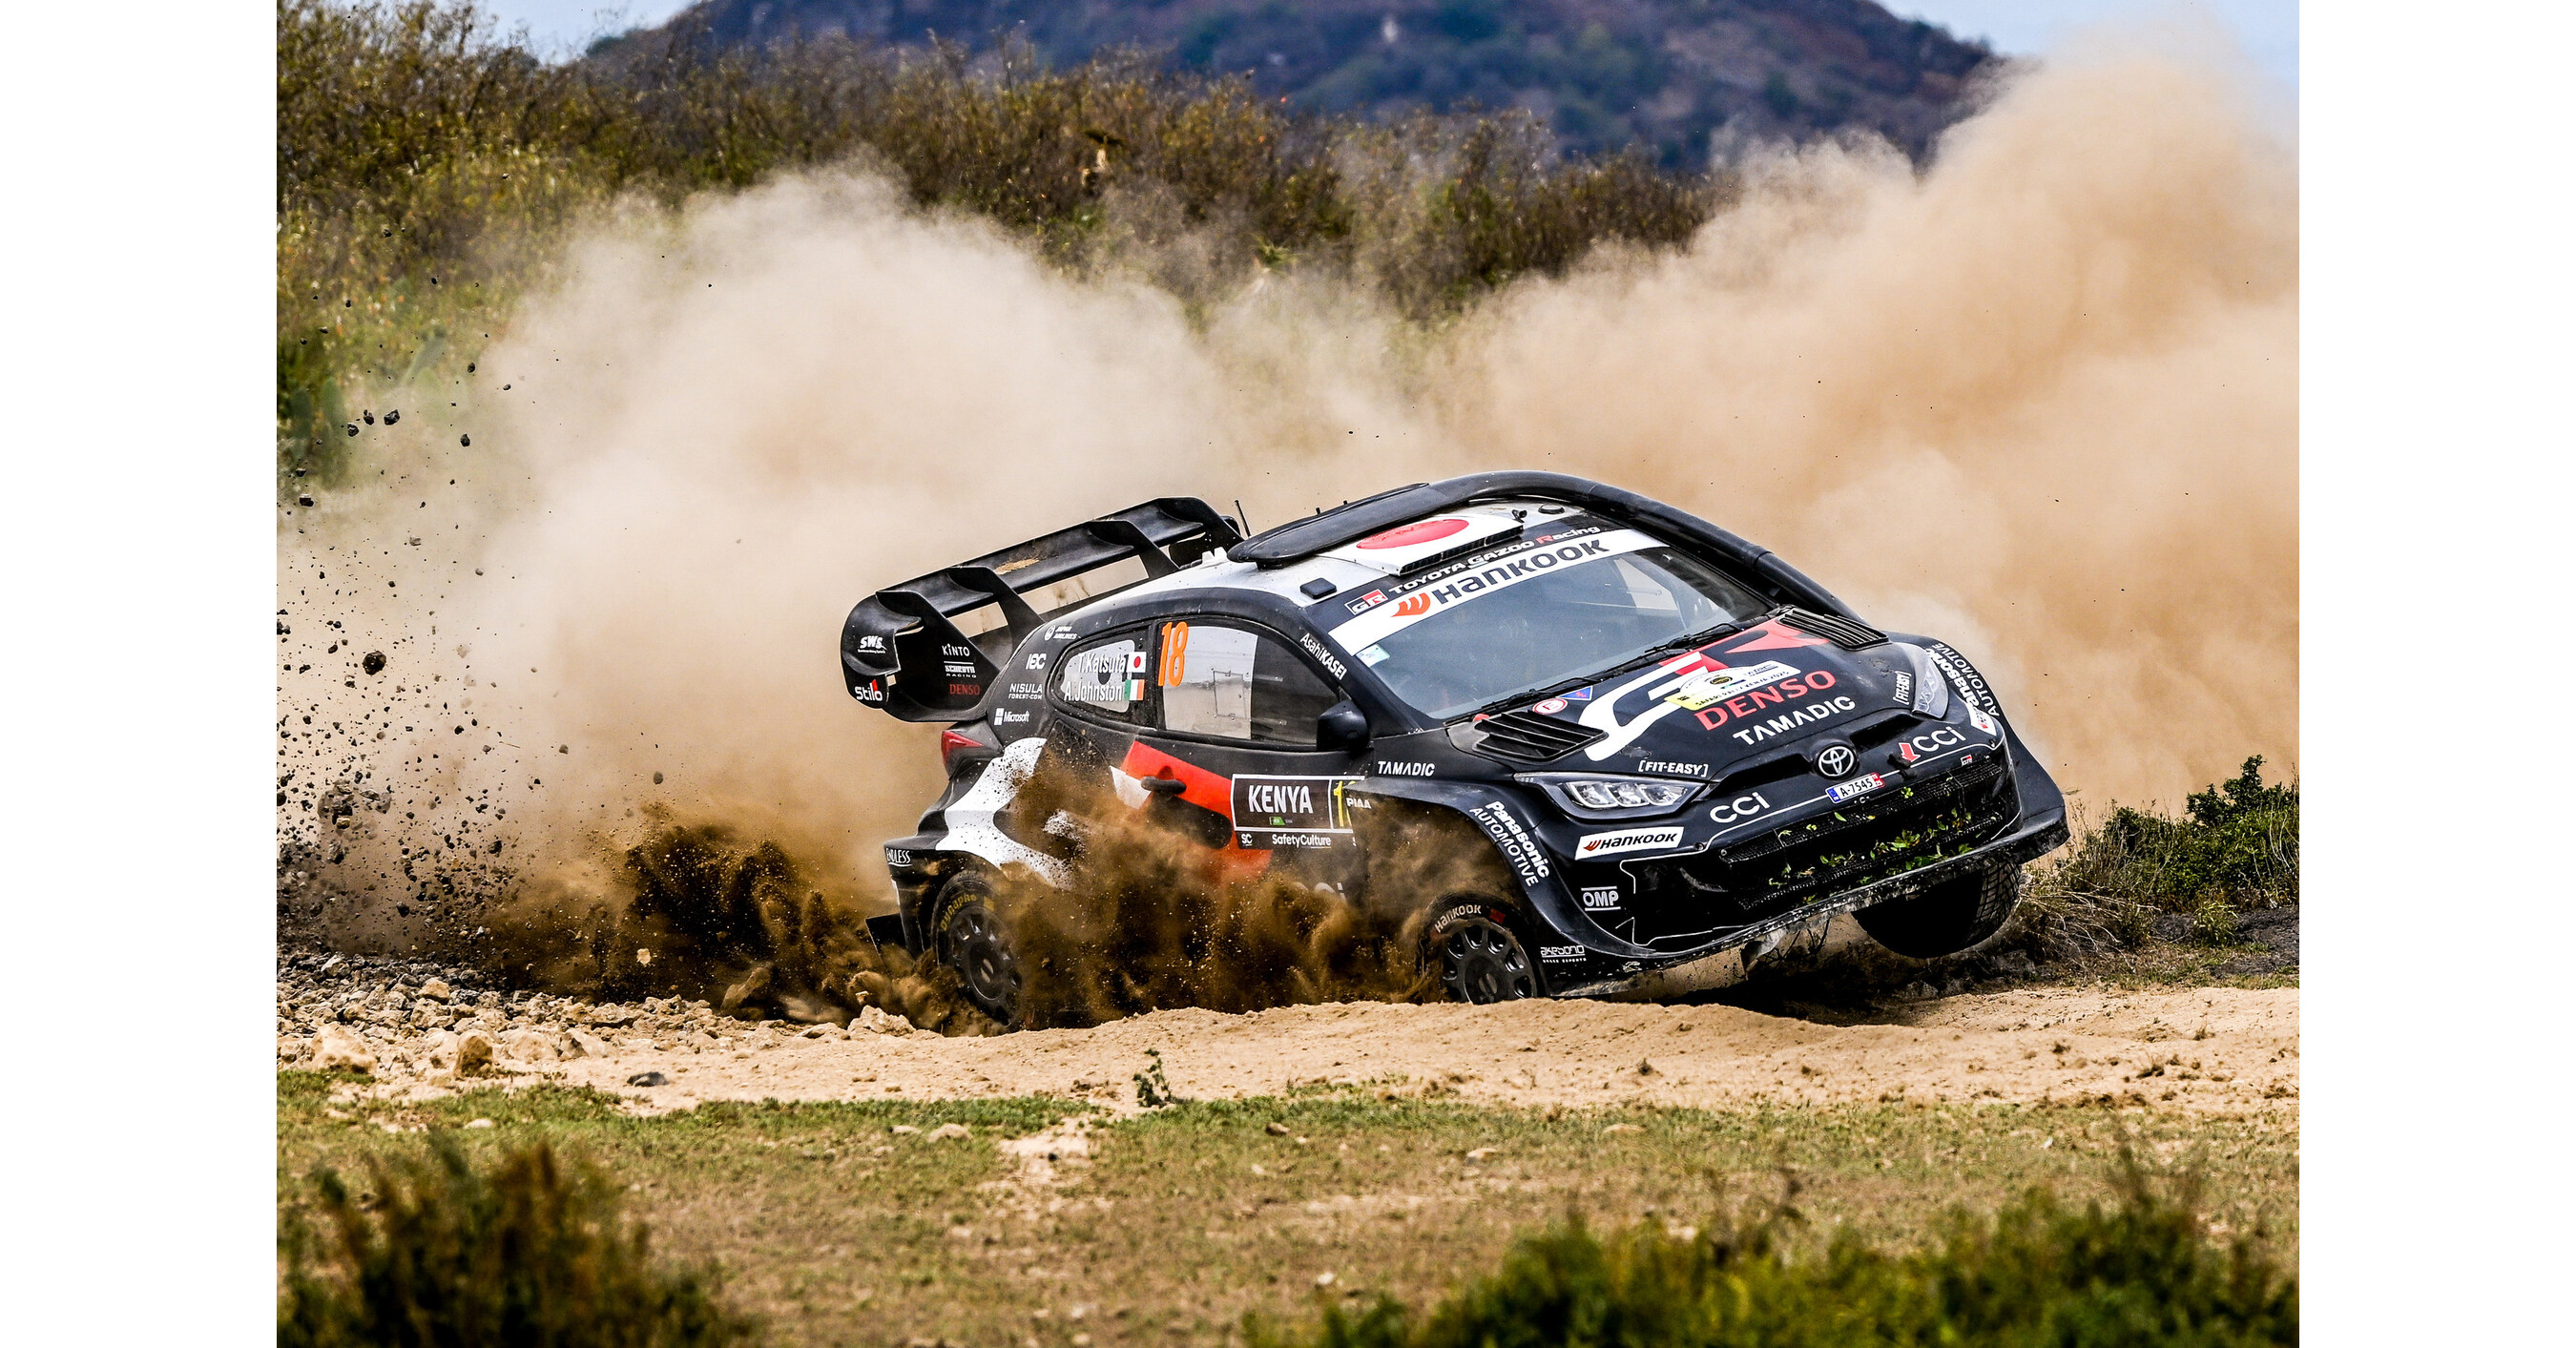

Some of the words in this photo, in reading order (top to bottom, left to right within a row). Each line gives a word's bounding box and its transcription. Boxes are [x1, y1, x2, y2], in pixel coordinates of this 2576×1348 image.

[1388, 563, 1466, 594] TOYOTA
[1466, 540, 1534, 568] GAZOO
[1536, 526, 1601, 545] Racing
[860, 635, 886, 650] SWS
[1078, 653, 1126, 674] T.Katsuta
[1157, 621, 1189, 687] 18
[1299, 633, 1347, 680] AsahiKASEI
[949, 684, 981, 695] DENSO
[1009, 683, 1043, 694] NISULA
[1932, 643, 2000, 716] AUTOMOTIVE
[855, 682, 883, 701] Stilo
[1064, 681, 1122, 701] A.Johnston
[1694, 670, 1837, 731] DENSO
[1004, 710, 1030, 722] Microsoft
[1732, 695, 1856, 746] TAMADIC
[1377, 760, 1435, 777] TAMADIC
[1839, 778, 1873, 797] A-7545
[1248, 785, 1314, 814] KENYA
[1346, 798, 1371, 809] PIAA
[1241, 834, 1253, 844] SC
[1272, 834, 1332, 848] SafetyCulture
[1469, 807, 1539, 887] AUTOMOTIVE
[1485, 800, 1549, 878] Panasonic
[1583, 890, 1619, 907] OMP
